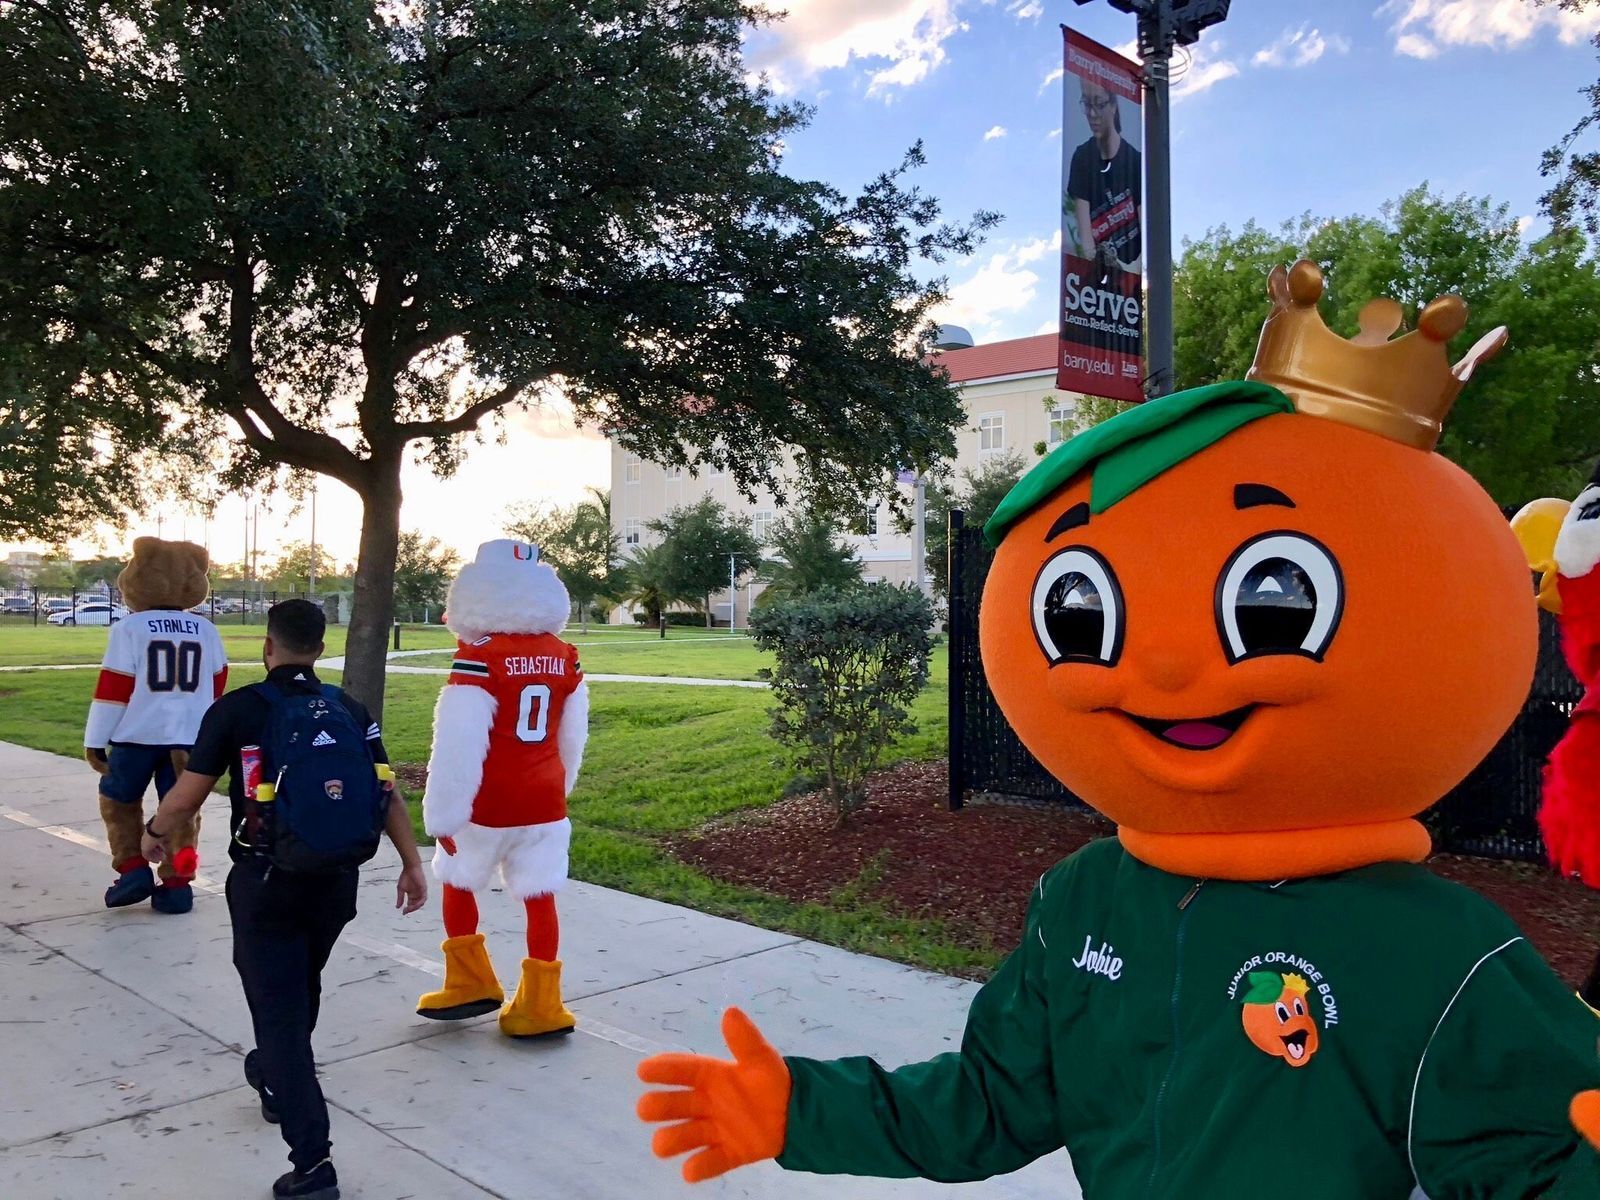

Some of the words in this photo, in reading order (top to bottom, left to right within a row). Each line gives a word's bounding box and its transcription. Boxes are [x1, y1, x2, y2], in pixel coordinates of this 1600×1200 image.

[1065, 272, 1140, 325] Serve
[1063, 349, 1115, 376] barry.edu
[513, 544, 533, 561] U
[147, 619, 200, 635] STANLEY
[146, 639, 202, 693] 00
[504, 655, 566, 676] SEBASTIAN
[515, 683, 552, 743] 0
[312, 738, 337, 747] adidas
[1071, 934, 1124, 981] Jobie
[1227, 955, 1263, 1000] JUNIOR
[1264, 951, 1323, 983] ORANGE
[1317, 983, 1339, 1029] BOWL
